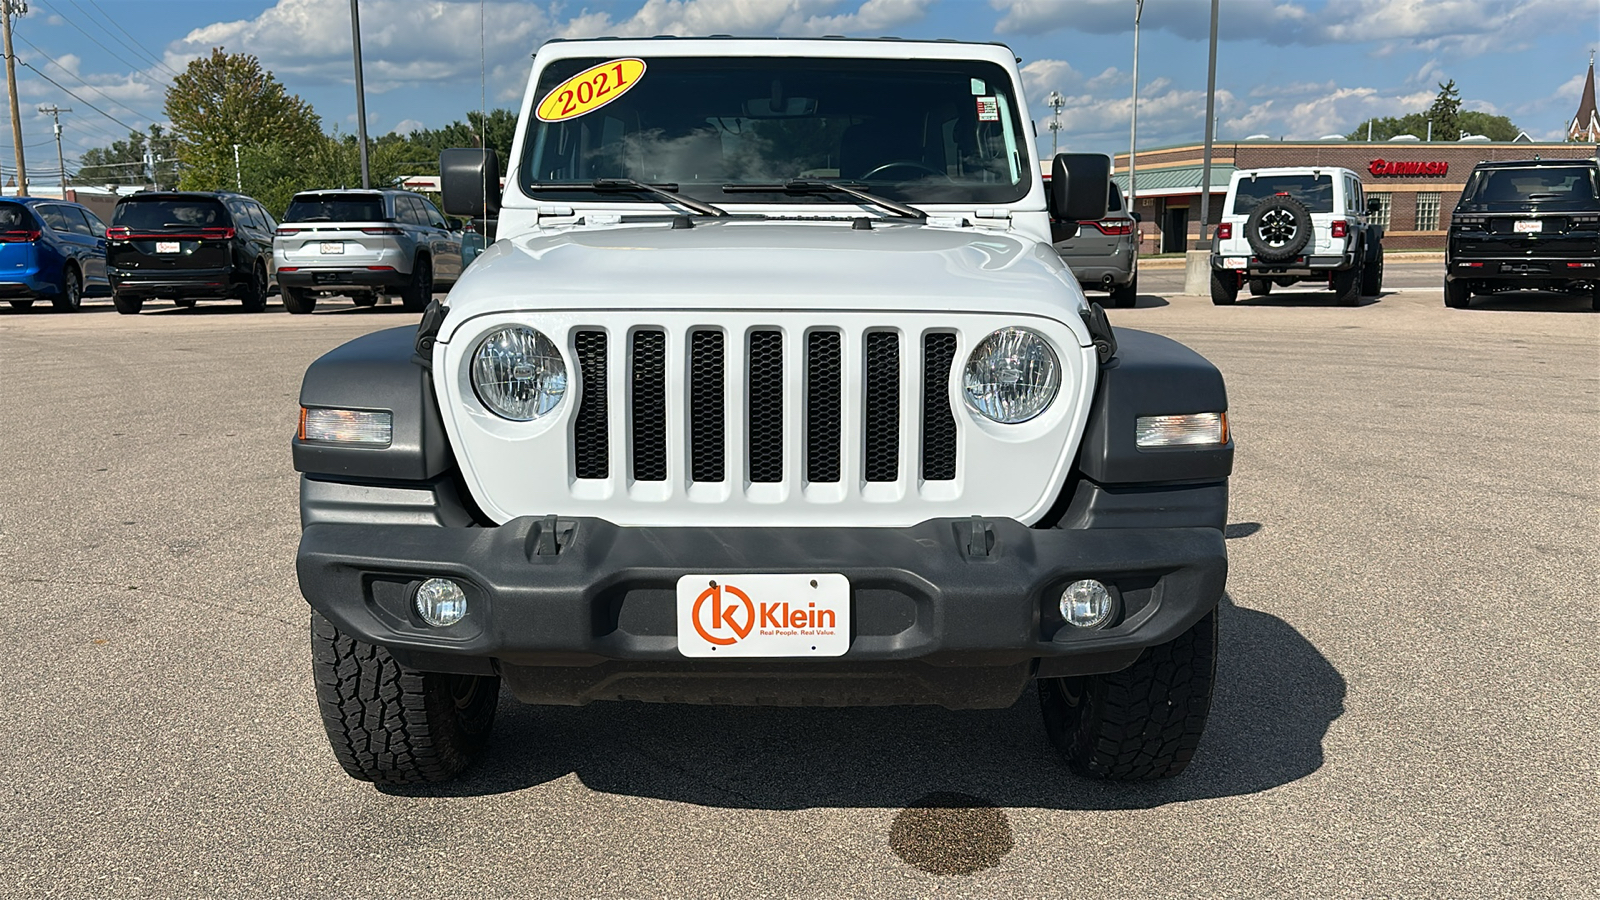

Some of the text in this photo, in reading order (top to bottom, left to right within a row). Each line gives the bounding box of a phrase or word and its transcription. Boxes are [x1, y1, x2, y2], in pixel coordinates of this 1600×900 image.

[558, 63, 627, 116] 2021
[1369, 158, 1449, 176] CARWASH
[760, 602, 836, 629] Klein
